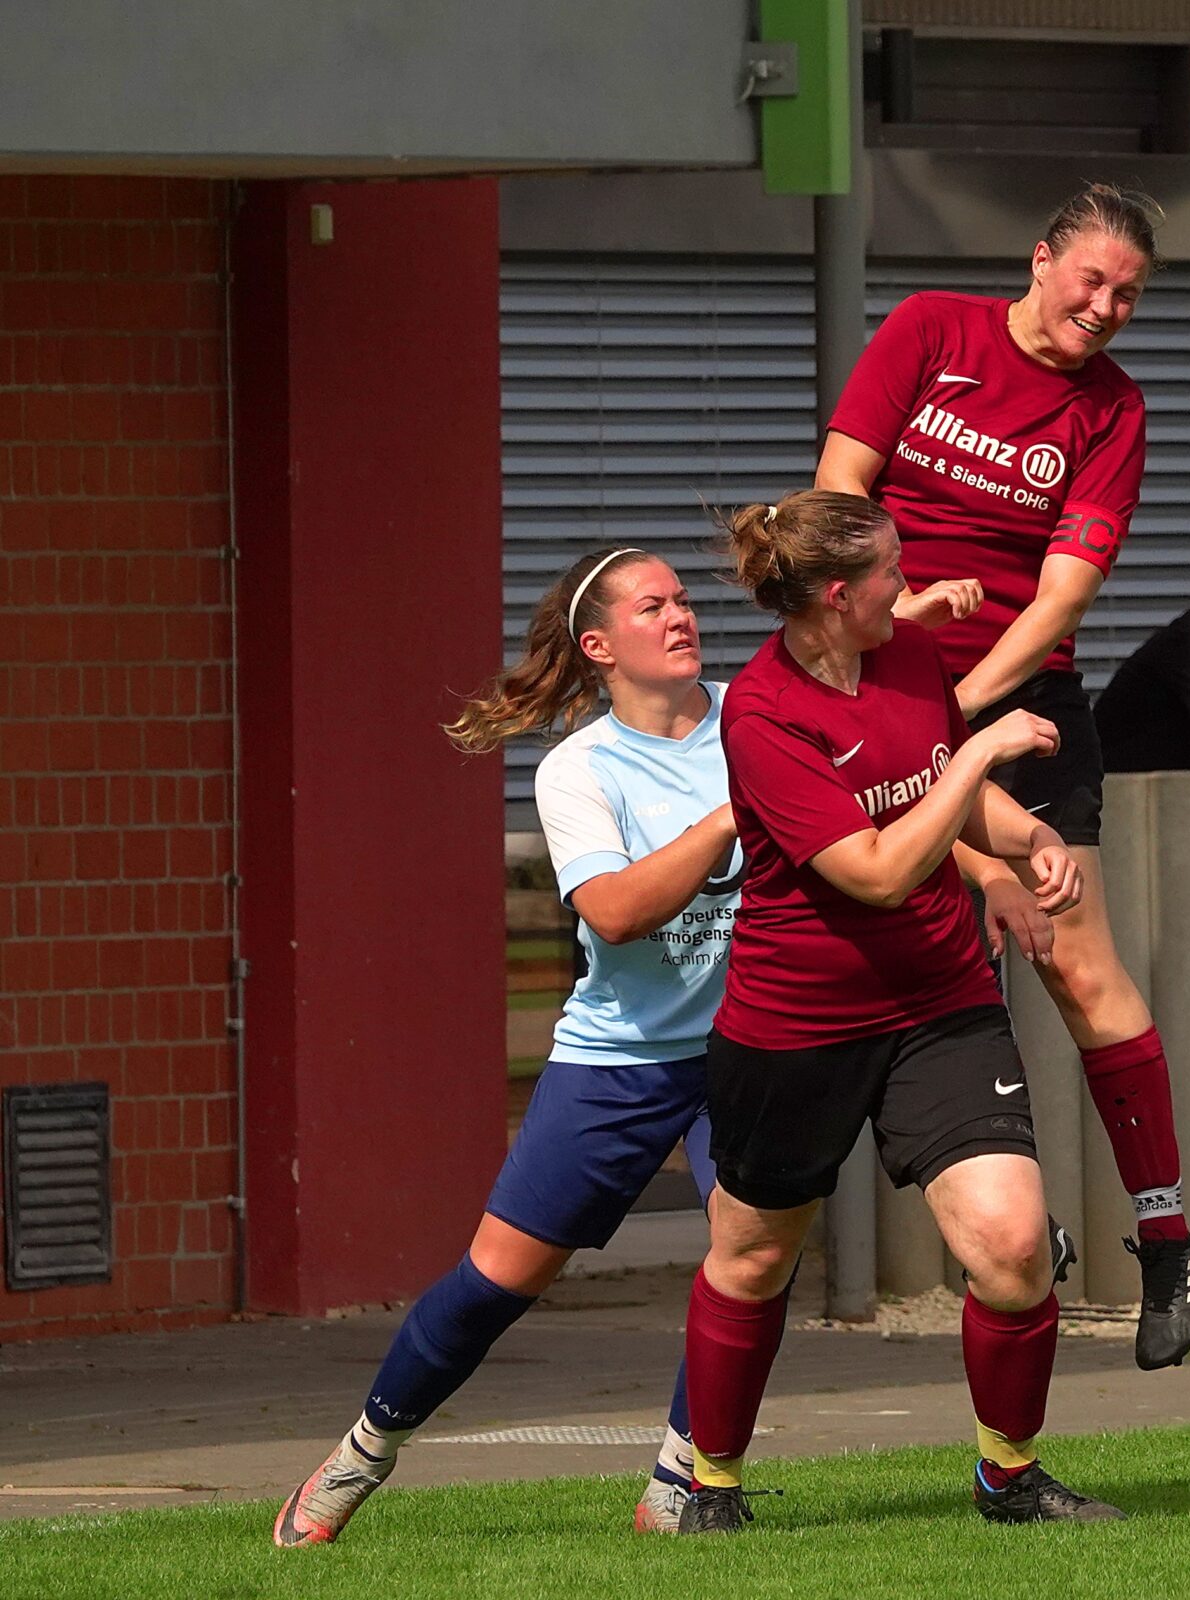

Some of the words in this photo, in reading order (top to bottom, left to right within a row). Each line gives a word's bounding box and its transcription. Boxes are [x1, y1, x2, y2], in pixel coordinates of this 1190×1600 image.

[910, 403, 1018, 468] Allianz
[896, 440, 932, 468] Kunz
[933, 458, 946, 475] &
[950, 464, 1011, 499] Siebert
[1013, 489, 1050, 511] OHG
[642, 928, 732, 947] ermögens
[661, 951, 710, 966] Achim
[1136, 1200, 1173, 1213] adidas
